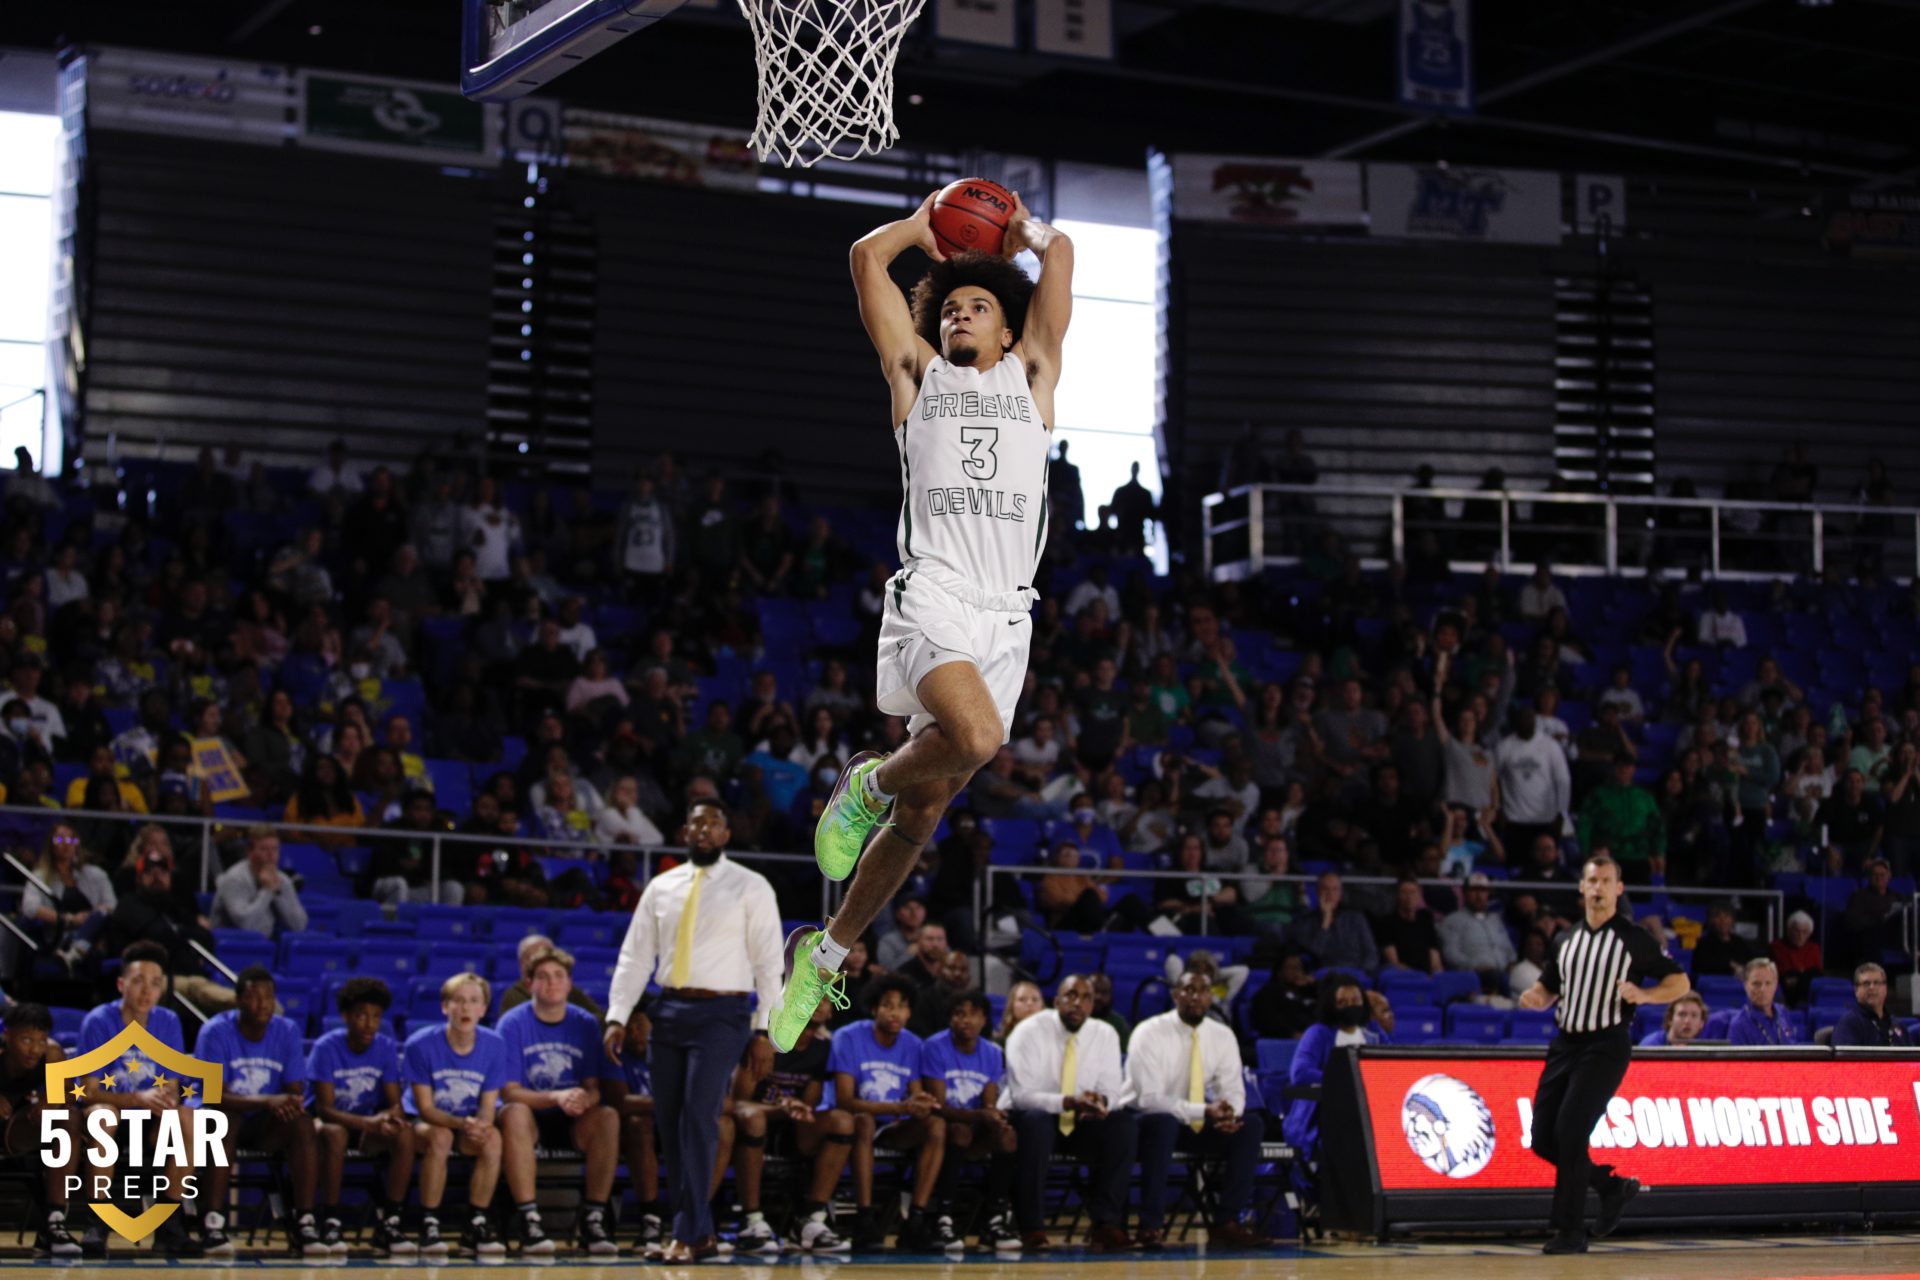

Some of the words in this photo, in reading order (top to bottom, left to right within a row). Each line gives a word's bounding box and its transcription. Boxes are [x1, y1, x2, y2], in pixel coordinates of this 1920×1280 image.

[962, 187, 1008, 214] NCAA
[1588, 184, 1613, 215] P
[922, 391, 1031, 423] GREENE
[961, 426, 998, 480] 3
[928, 487, 1027, 522] DEVILS
[1517, 1097, 1688, 1148] JSON
[1687, 1097, 1811, 1147] NORTH
[1812, 1096, 1898, 1145] SIDE
